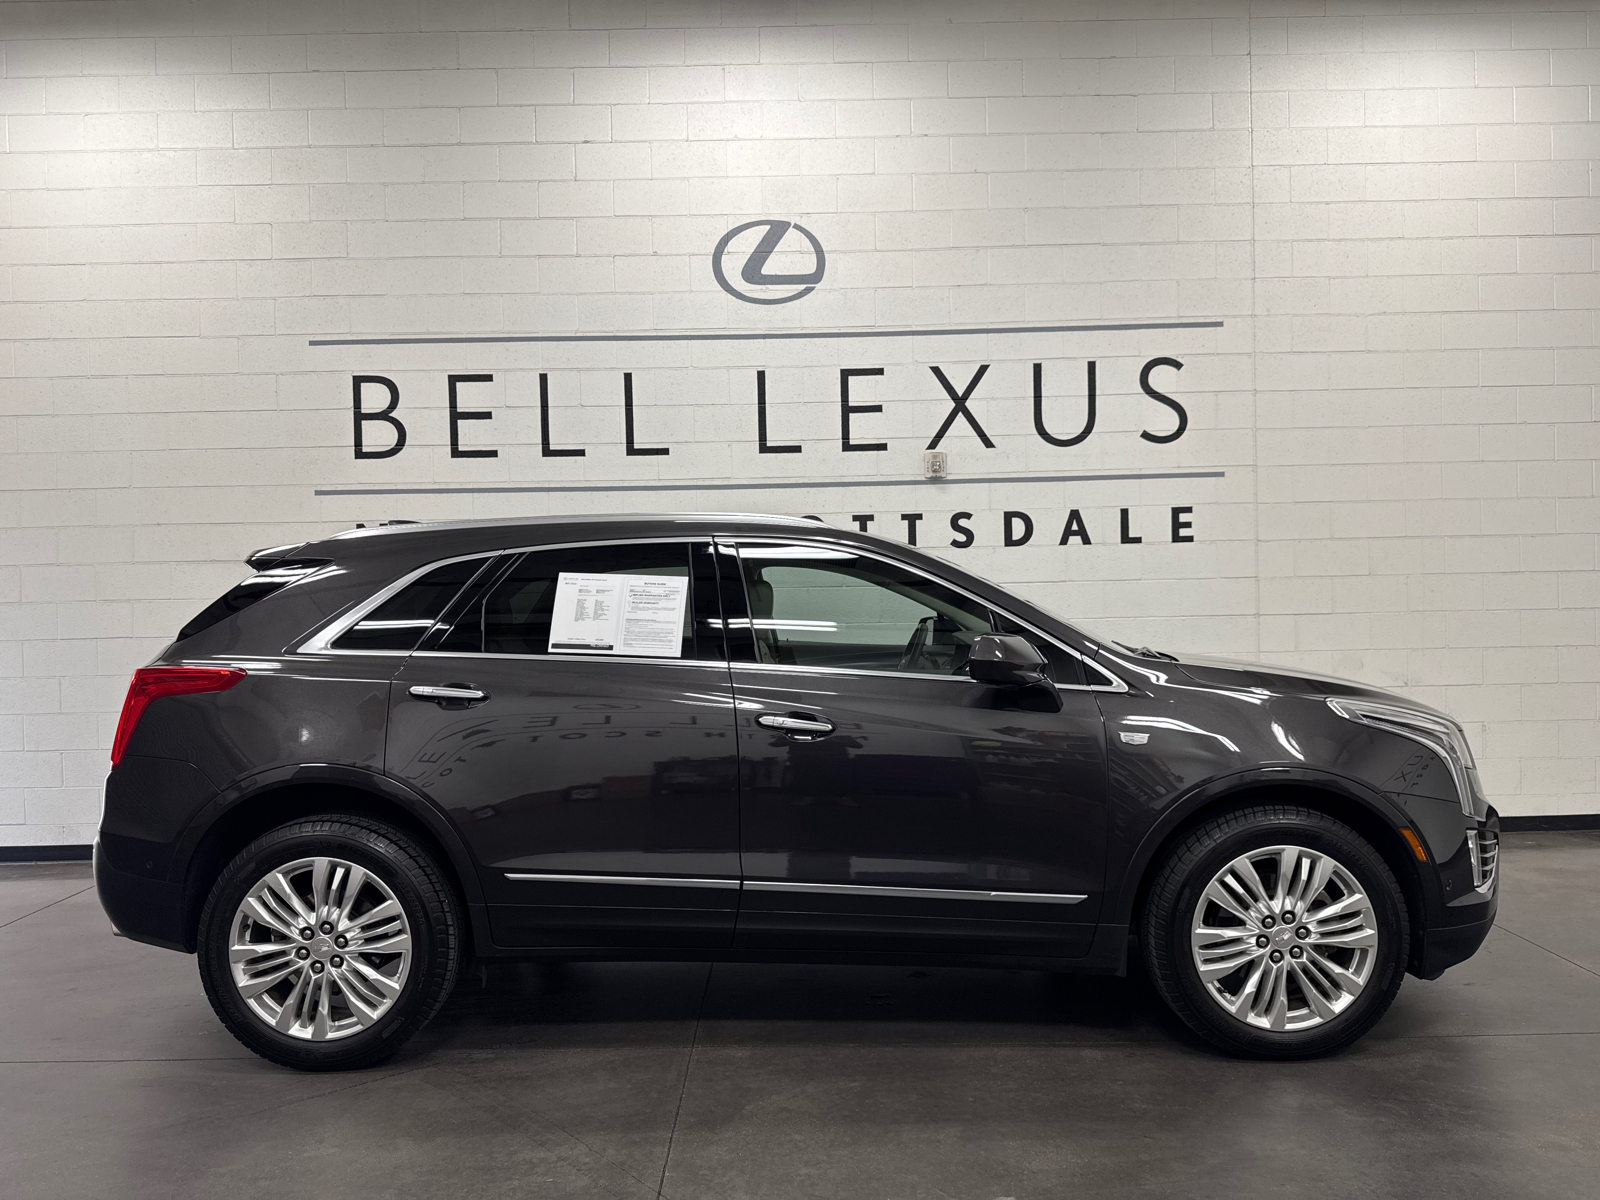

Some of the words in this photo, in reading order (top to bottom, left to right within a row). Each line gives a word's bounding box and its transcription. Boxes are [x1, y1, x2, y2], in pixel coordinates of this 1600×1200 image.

[352, 372, 670, 460] BELL
[756, 356, 1189, 454] LEXUS
[801, 506, 1195, 549] TTSDALE
